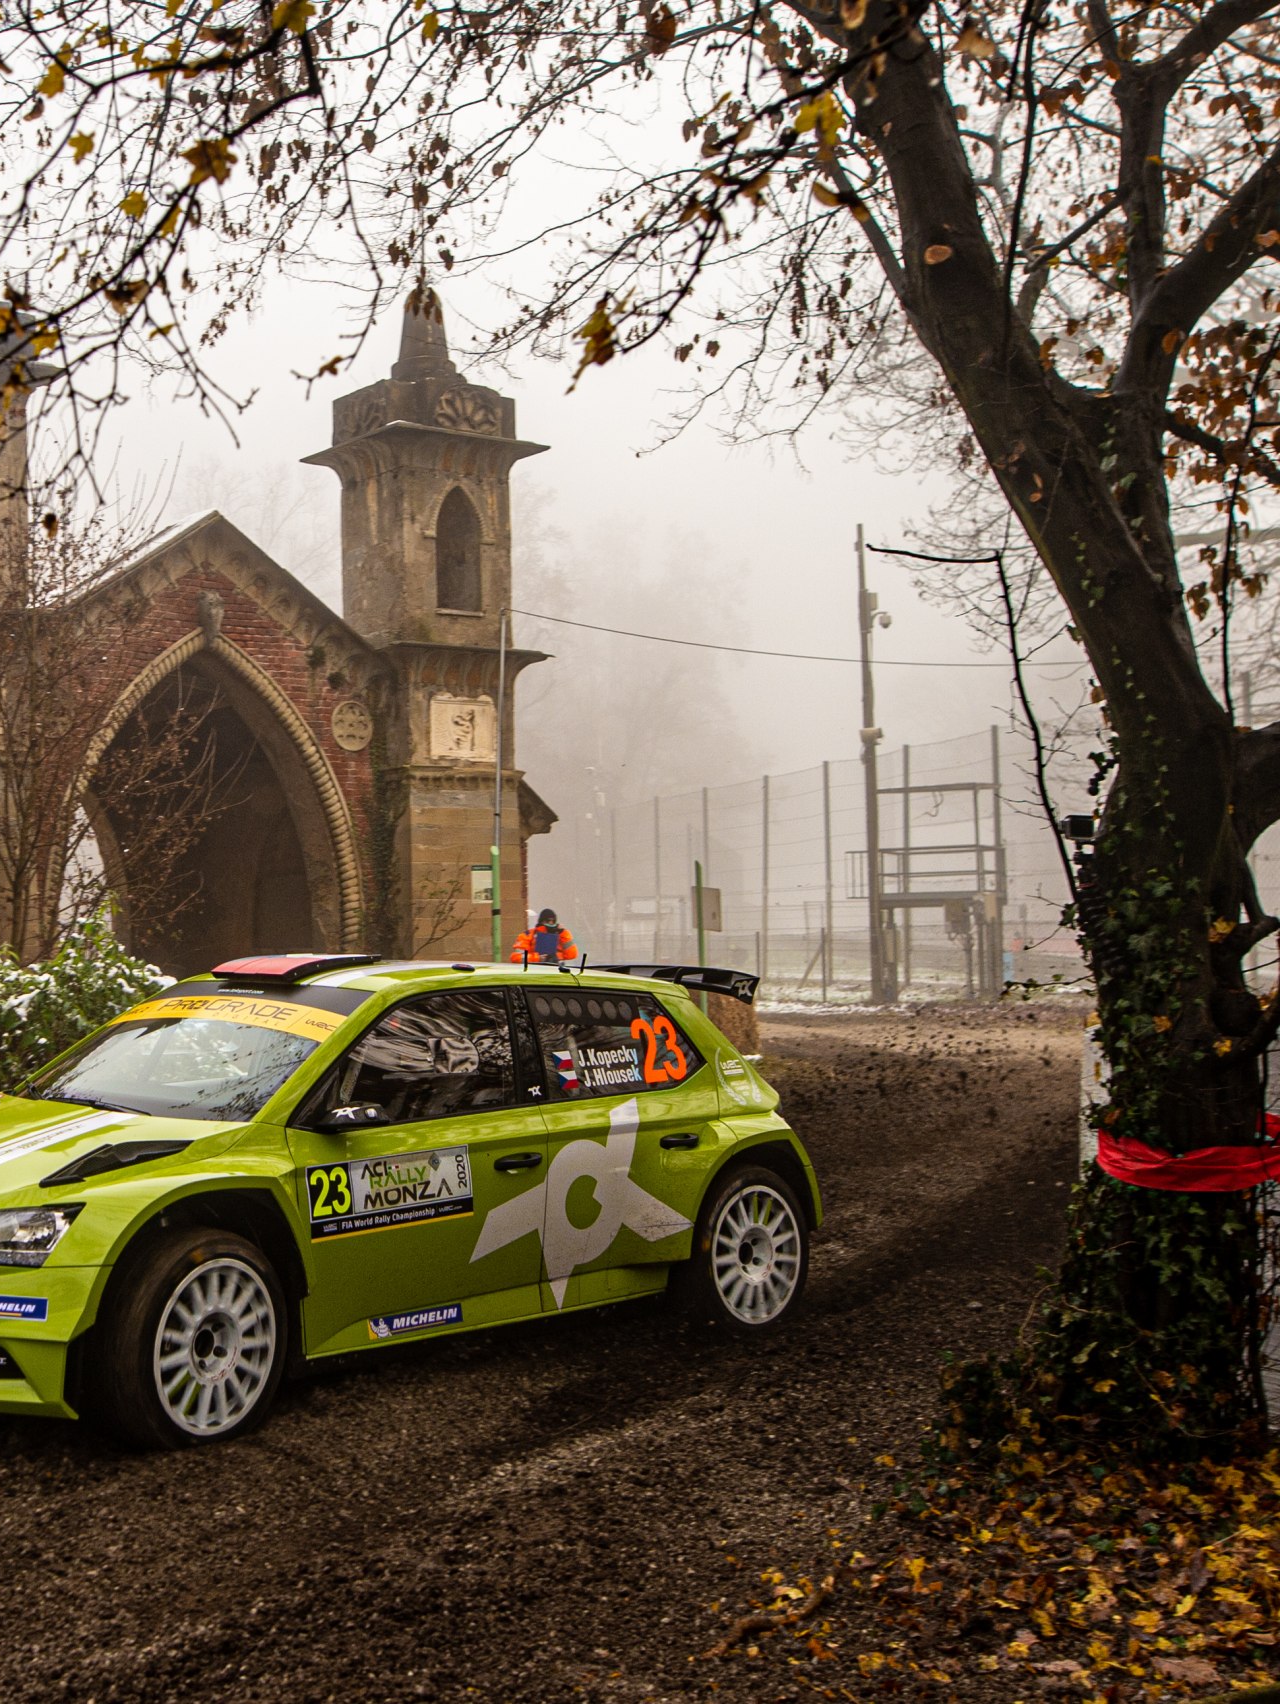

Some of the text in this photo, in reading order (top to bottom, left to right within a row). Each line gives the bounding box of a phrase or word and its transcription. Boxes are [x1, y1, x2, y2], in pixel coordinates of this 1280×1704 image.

[159, 999, 298, 1021] PROGRADE
[212, 1011, 280, 1027] DIGITAL
[578, 1045, 639, 1068] J.Kopecky
[630, 1015, 687, 1084] 23
[584, 1065, 643, 1088] J.Hlousek
[361, 1161, 388, 1180] ACI
[370, 1165, 427, 1190] RALLY
[455, 1154, 468, 1189] 2020
[310, 1166, 351, 1217] 23
[363, 1178, 453, 1210] MONZA
[341, 1206, 436, 1230] FIA World Rally Championship
[392, 1307, 458, 1329] MICHELIN
